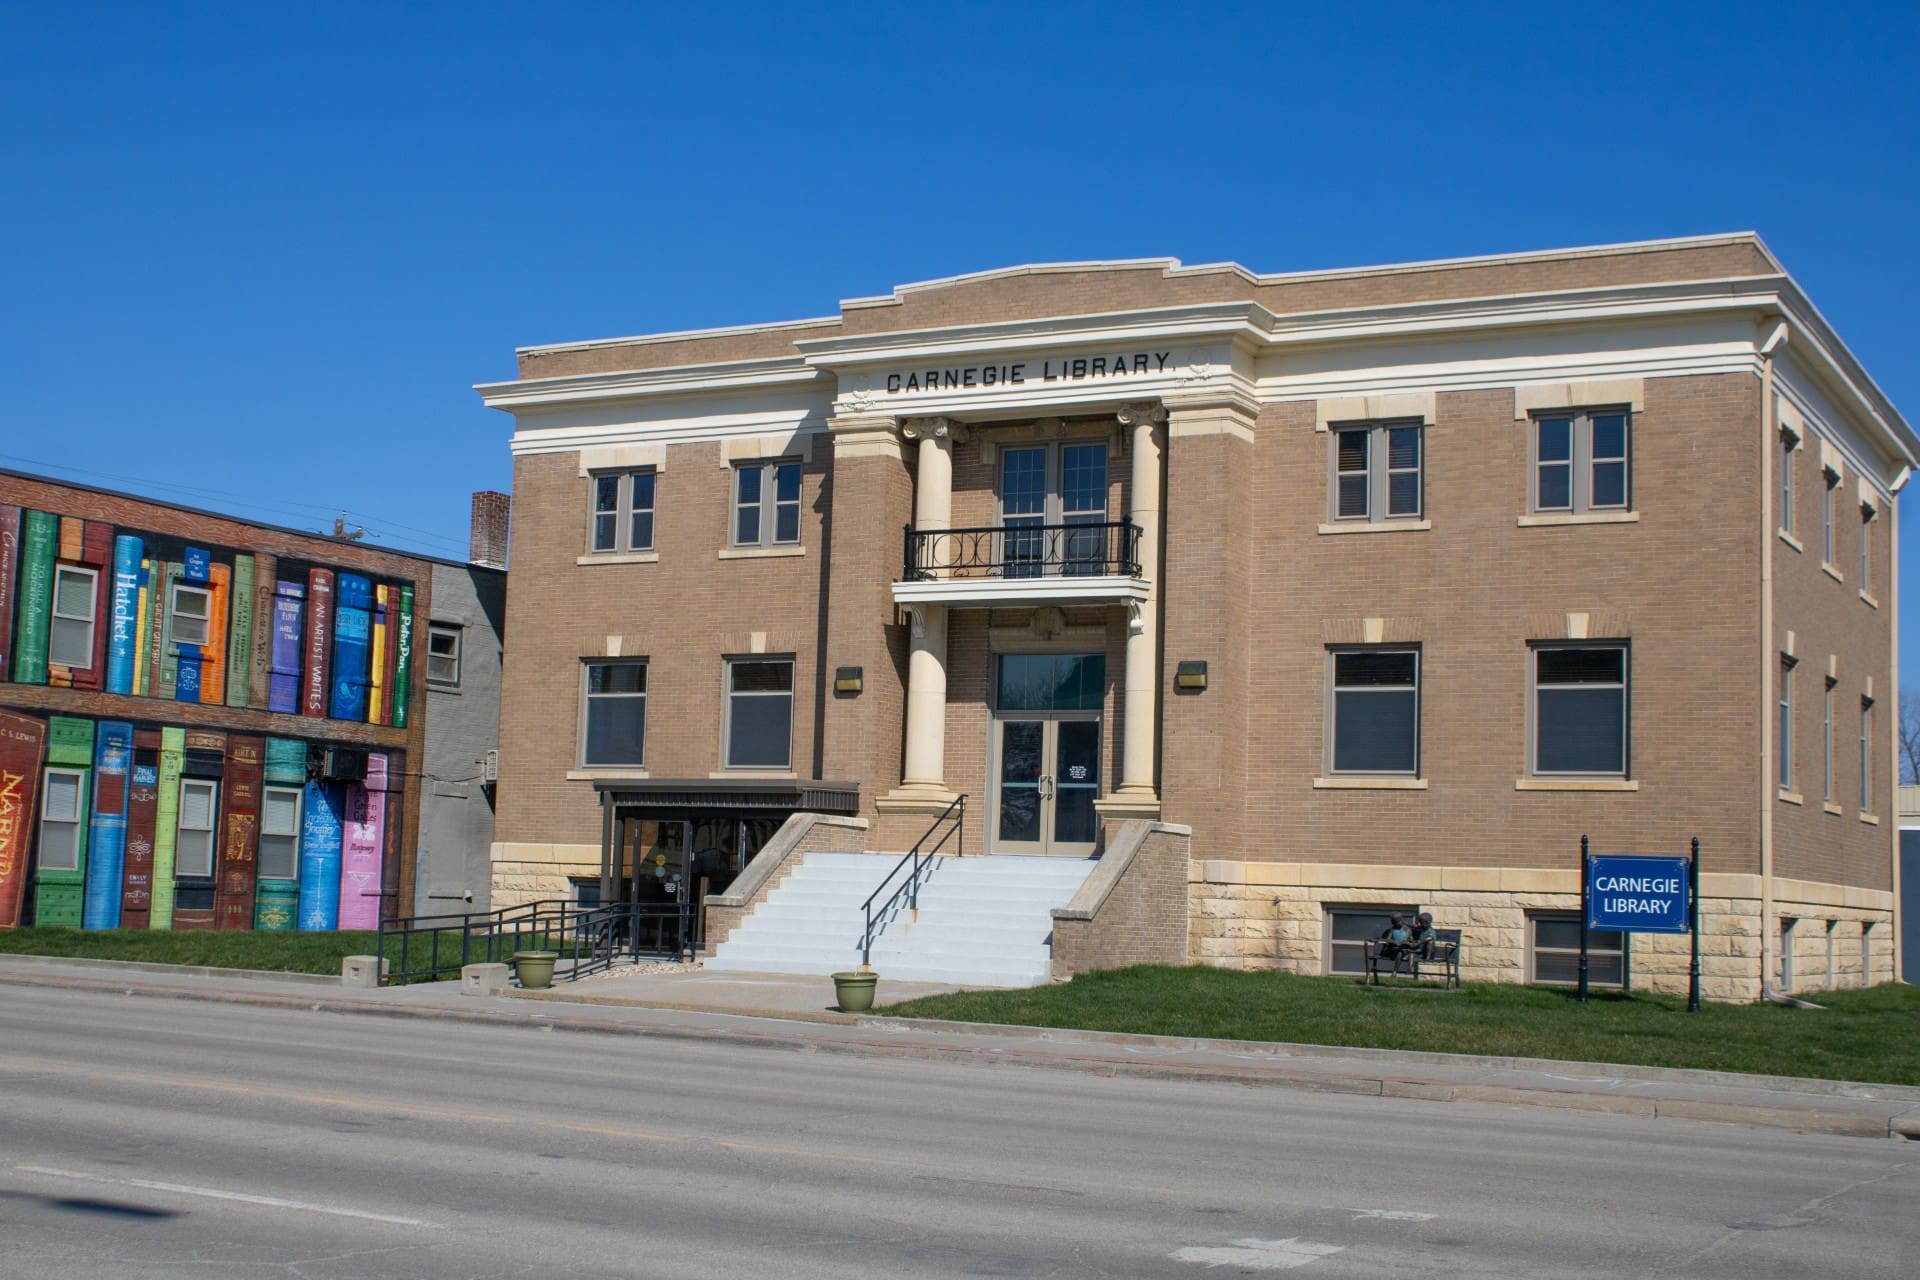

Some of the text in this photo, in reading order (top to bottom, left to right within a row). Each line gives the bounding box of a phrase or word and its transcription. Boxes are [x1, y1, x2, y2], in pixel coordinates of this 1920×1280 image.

[887, 363, 1026, 394] CARNEGIE
[113, 573, 137, 642] Hatchet
[316, 602, 325, 618] AN
[313, 621, 323, 661] ARTIST
[309, 665, 321, 710] WRITES
[15, 731, 36, 743] LEWIS
[137, 767, 152, 776] FINAL
[0, 769, 25, 885] NARNI
[1596, 877, 1680, 894] CARNEGIE
[1604, 898, 1672, 914] LIBRARY
